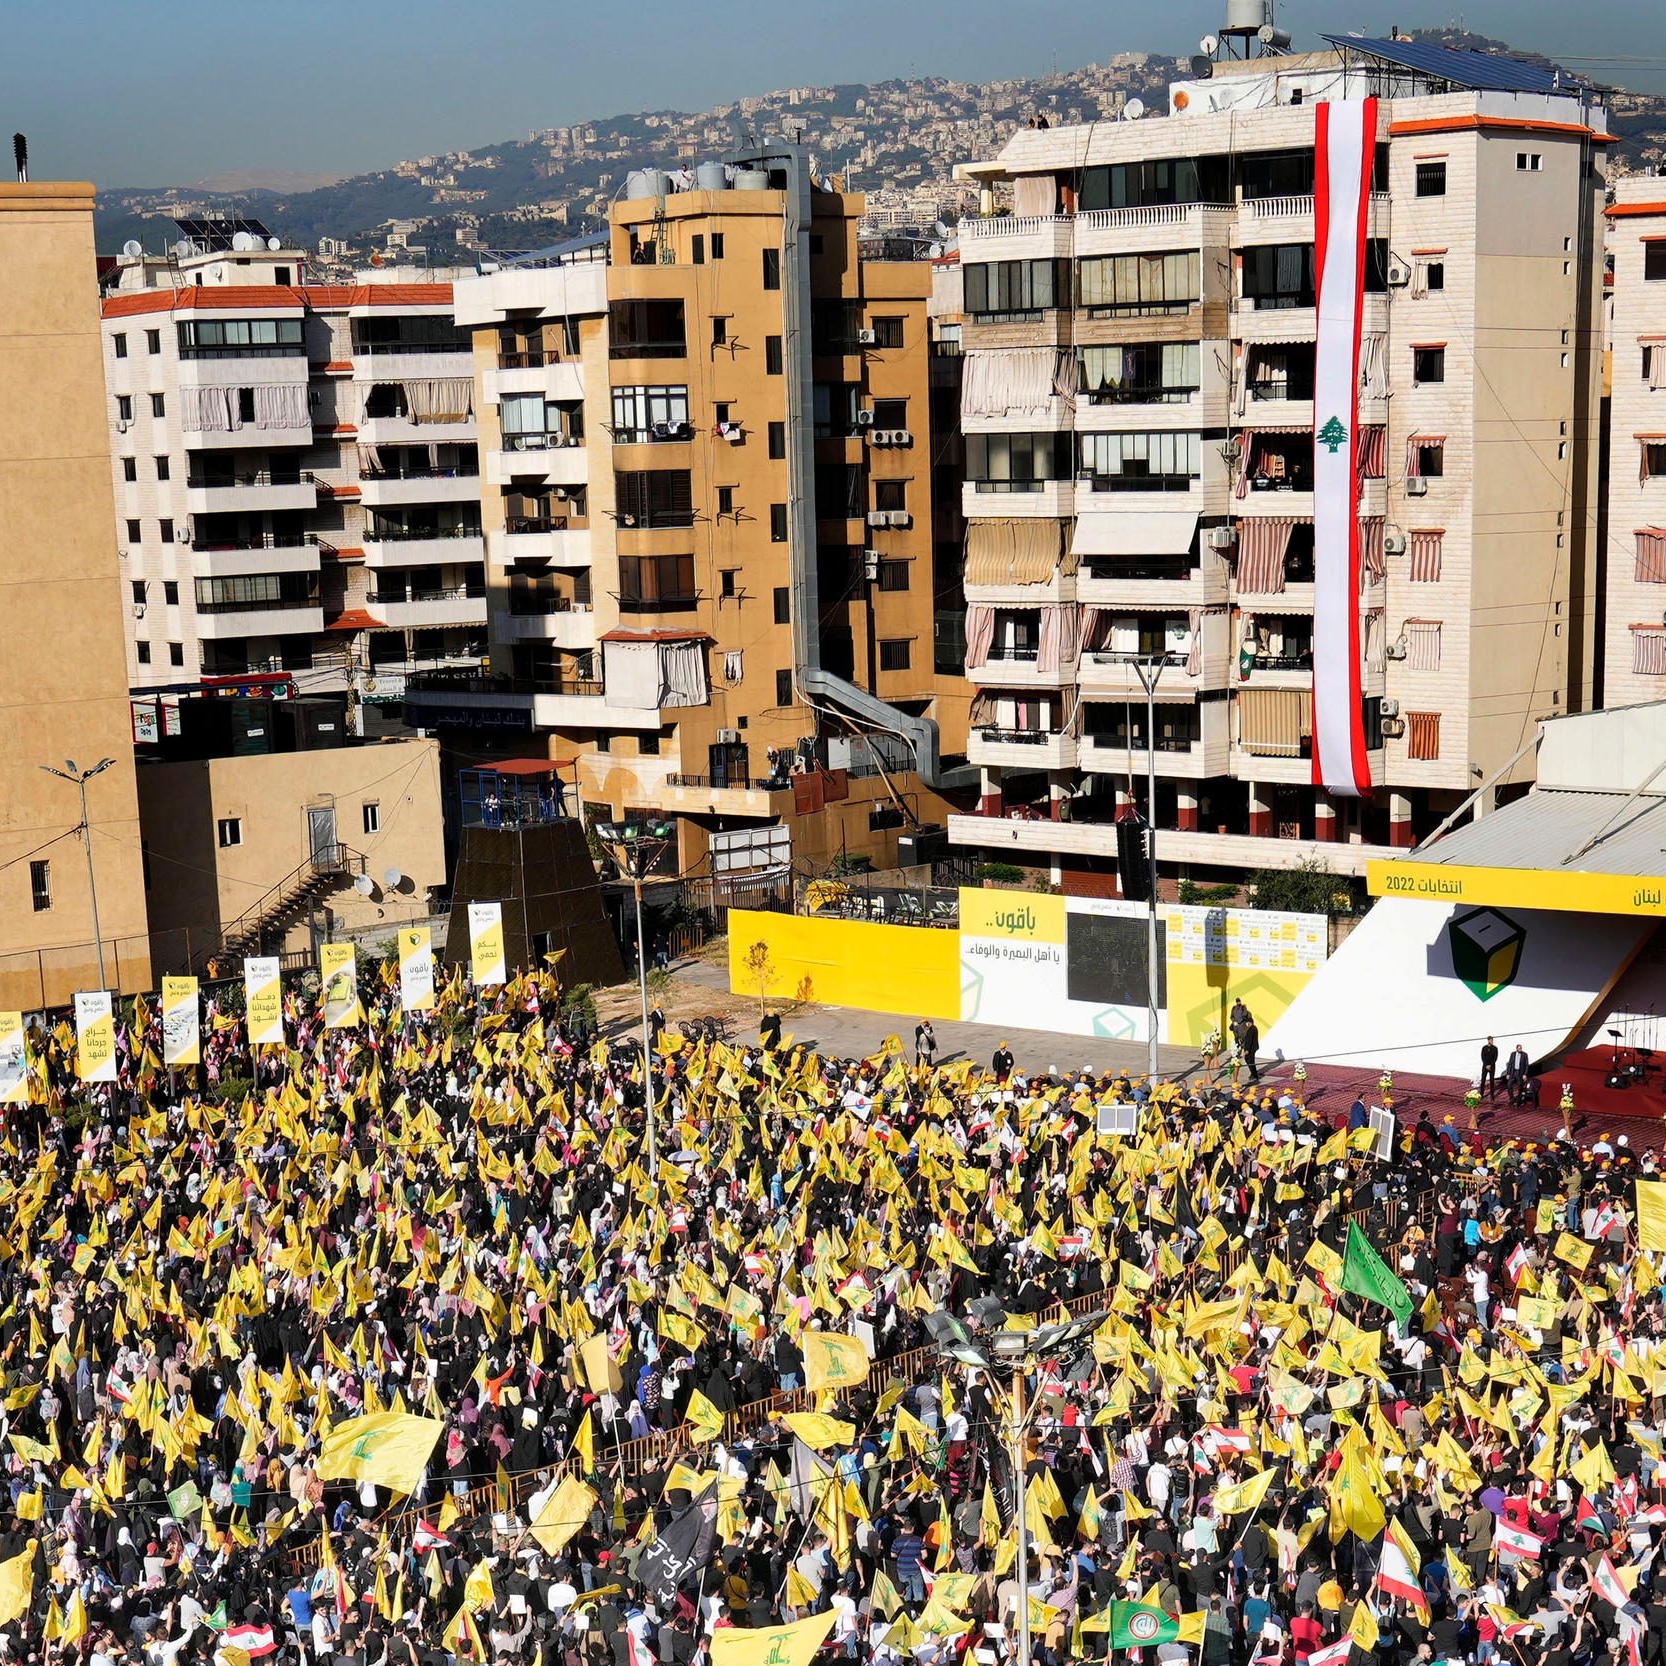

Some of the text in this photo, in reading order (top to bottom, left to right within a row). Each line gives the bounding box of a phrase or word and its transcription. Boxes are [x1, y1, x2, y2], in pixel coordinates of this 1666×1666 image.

[1386, 876, 1462, 896] انتخابات 2022
[1634, 889, 1661, 907] لبنان
[1003, 946, 1032, 961] البصيرة
[1034, 946, 1050, 962] أهل
[1053, 950, 1060, 964] يا
